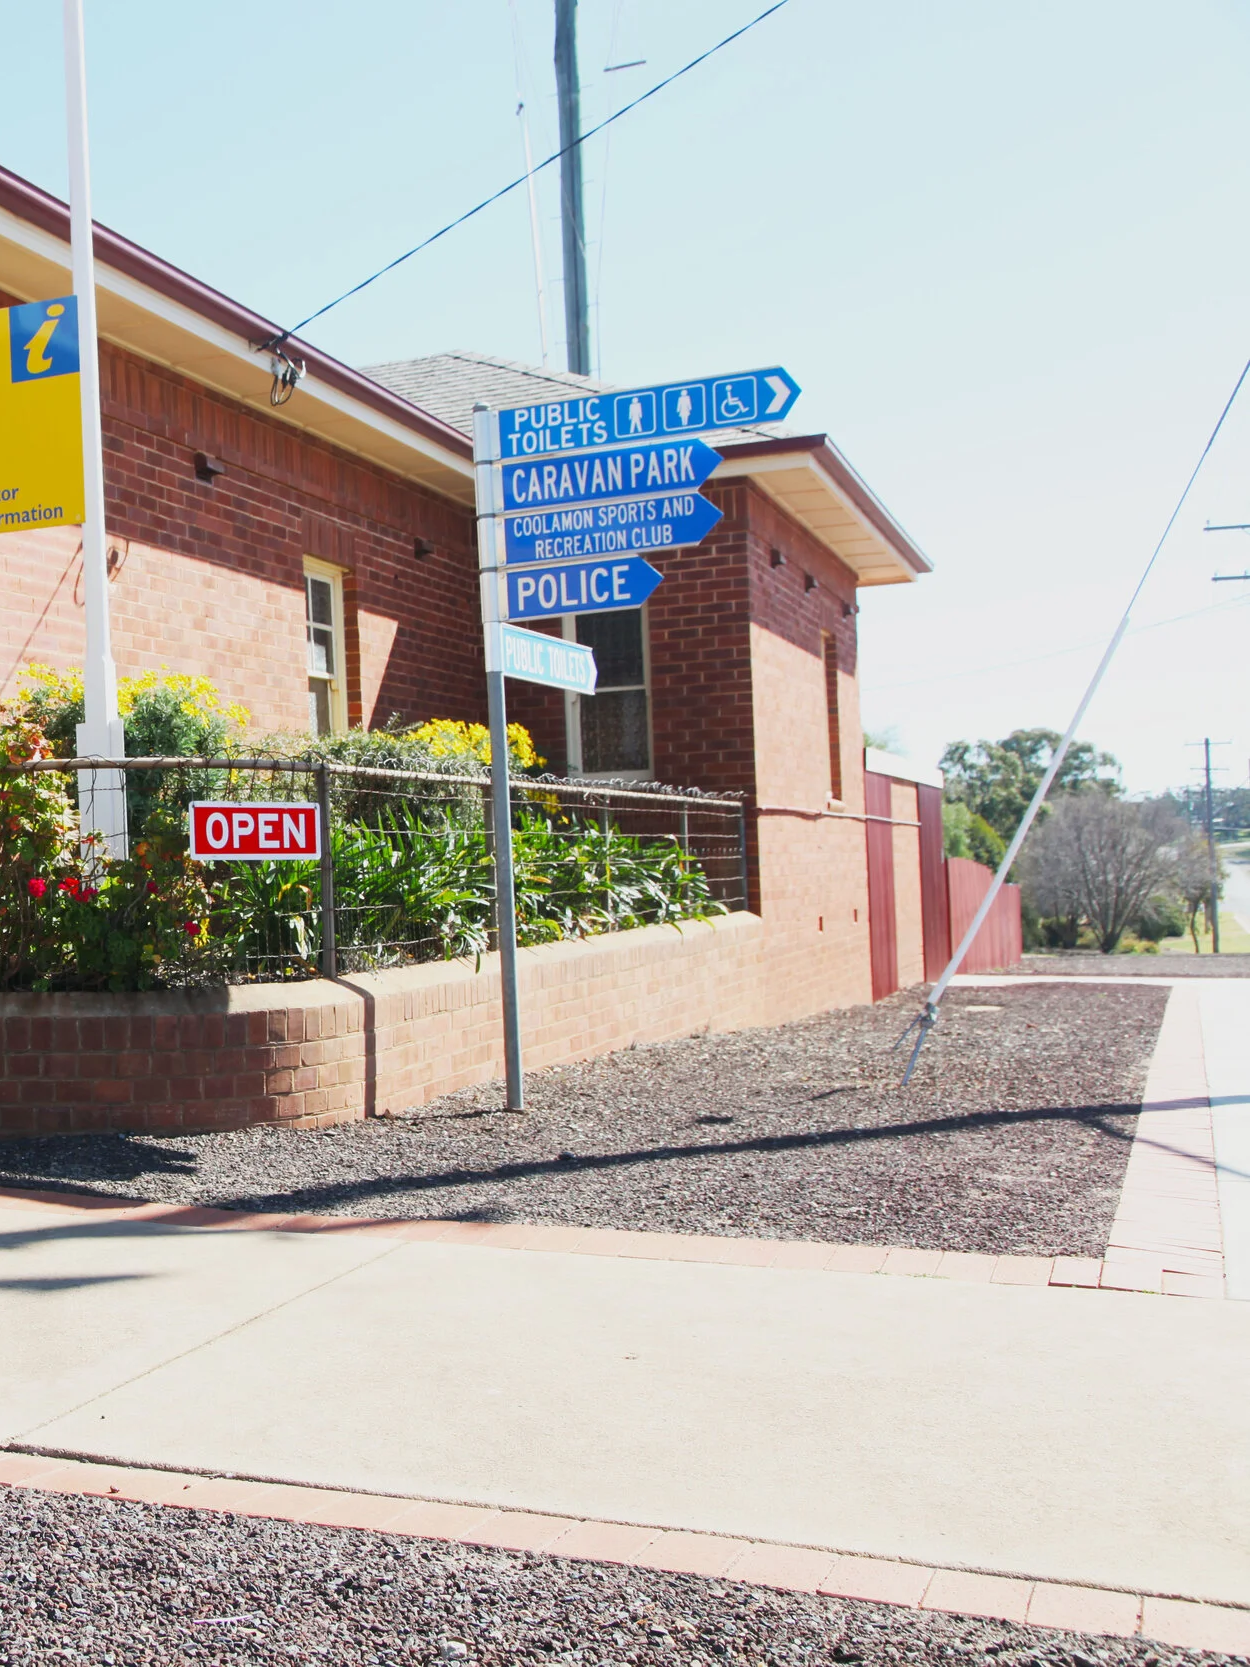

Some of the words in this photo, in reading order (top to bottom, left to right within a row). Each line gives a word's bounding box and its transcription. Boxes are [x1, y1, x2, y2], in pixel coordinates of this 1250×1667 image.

[514, 397, 600, 431] PUBLIC
[508, 420, 608, 455] TOILETS
[512, 455, 623, 503] CARAVAN
[630, 445, 696, 489] PARK
[513, 508, 593, 538] COOLAMON
[598, 500, 657, 526] SPORTS
[662, 496, 695, 519] AND
[535, 531, 628, 559] RECREATION
[631, 524, 673, 548] CLUB
[517, 564, 631, 611] POLICE
[505, 635, 544, 675] PUBLIC
[547, 645, 586, 684] TOILETS
[205, 812, 306, 849] OPEN
